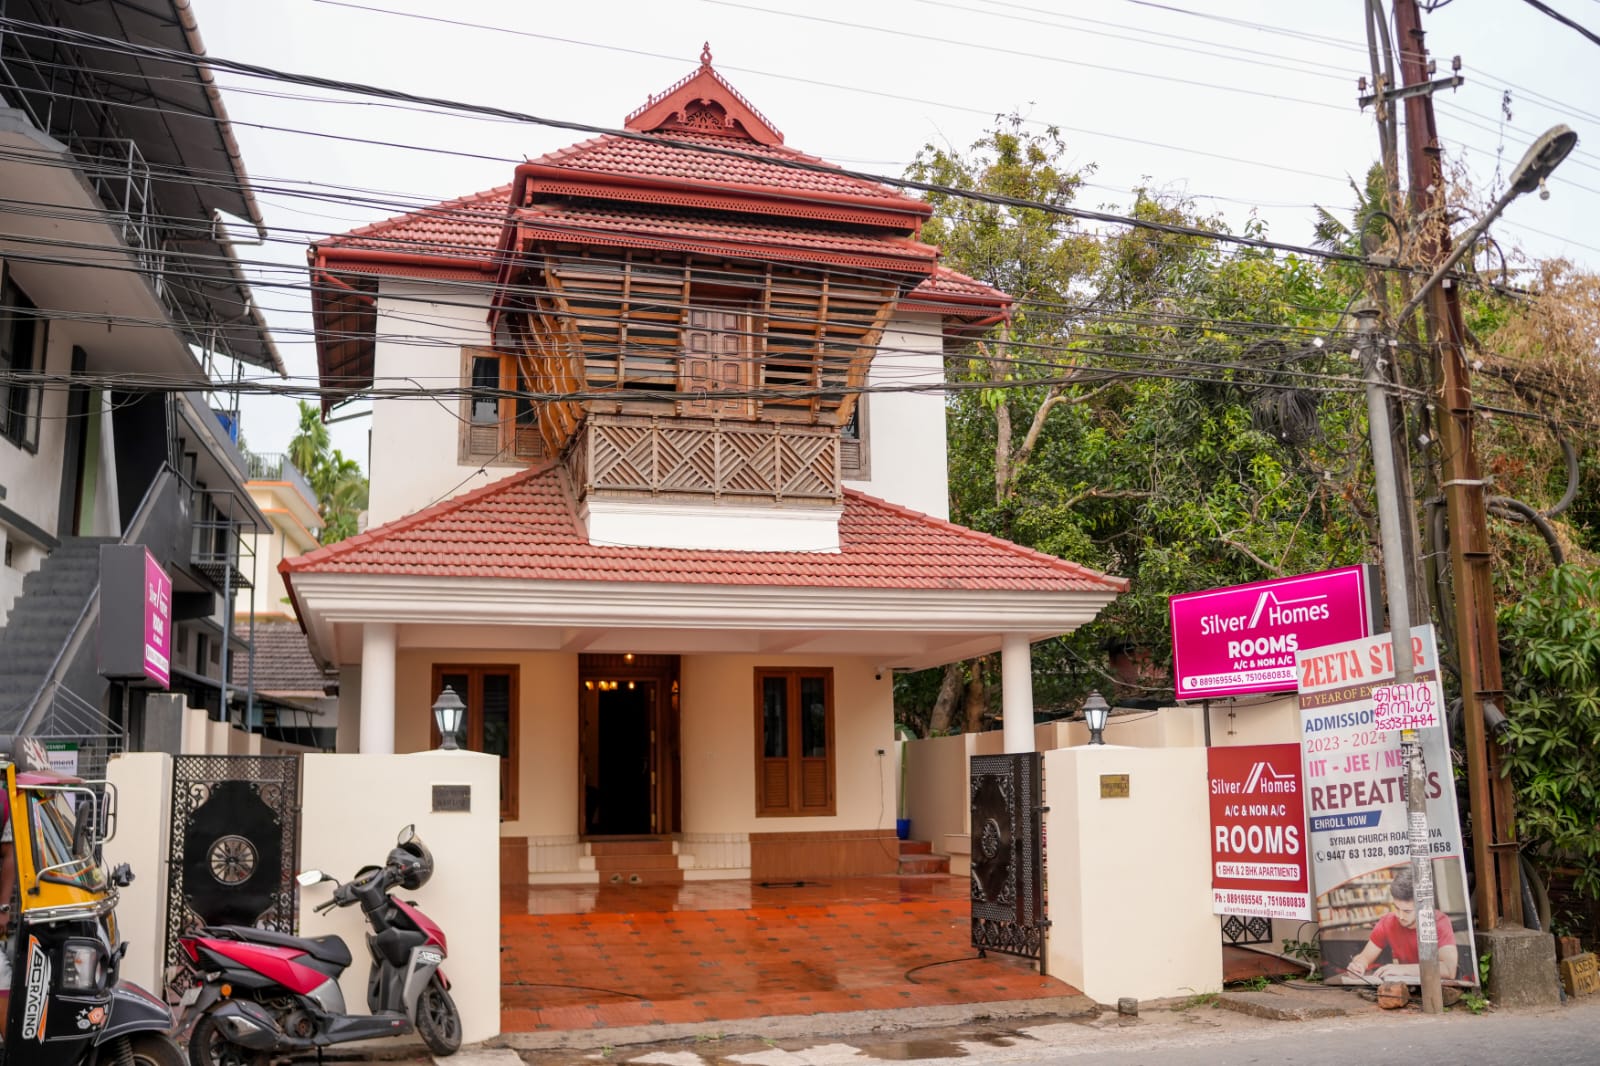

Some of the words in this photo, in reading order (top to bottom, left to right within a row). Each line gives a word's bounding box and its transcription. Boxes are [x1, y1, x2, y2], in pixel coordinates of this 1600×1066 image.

[1200, 614, 1247, 635] Silver
[1269, 603, 1330, 627] Homes
[1228, 633, 1298, 659] ROOMS
[1233, 660, 1248, 670] A/C
[1249, 660, 1256, 668] &
[1257, 658, 1276, 667] NON
[1277, 655, 1293, 666] A/C
[1300, 649, 1364, 688] ZEETA
[1369, 636, 1425, 675] STR
[1301, 697, 1312, 707] 17
[1314, 691, 1342, 705] YEAR
[1343, 687, 1358, 700] OF
[1306, 736, 1340, 753] 2023
[1352, 730, 1387, 747] 2024
[1309, 759, 1327, 778] IIT
[1343, 754, 1371, 773] JEE
[1211, 778, 1241, 795] Silver
[1260, 777, 1296, 793] Homes
[1225, 805, 1239, 817] A/C
[1241, 805, 1247, 816] &
[1249, 804, 1269, 816] NON
[1270, 804, 1286, 817] A/C
[1314, 816, 1346, 830] ENROLL
[1347, 814, 1367, 826] NOW
[1215, 825, 1299, 855] ROOMS
[1329, 835, 1356, 847] SYRIAN
[1357, 832, 1388, 844] CHURCH
[1326, 849, 1346, 861] 9447
[1348, 848, 1360, 859] 63
[1388, 844, 1410, 856] 9037
[1429, 841, 1452, 853] 1658
[1222, 865, 1235, 875] BHK
[1245, 866, 1258, 876] BHK
[1258, 866, 1298, 878] APARTMENTS
[24, 984, 40, 1038] RACING
